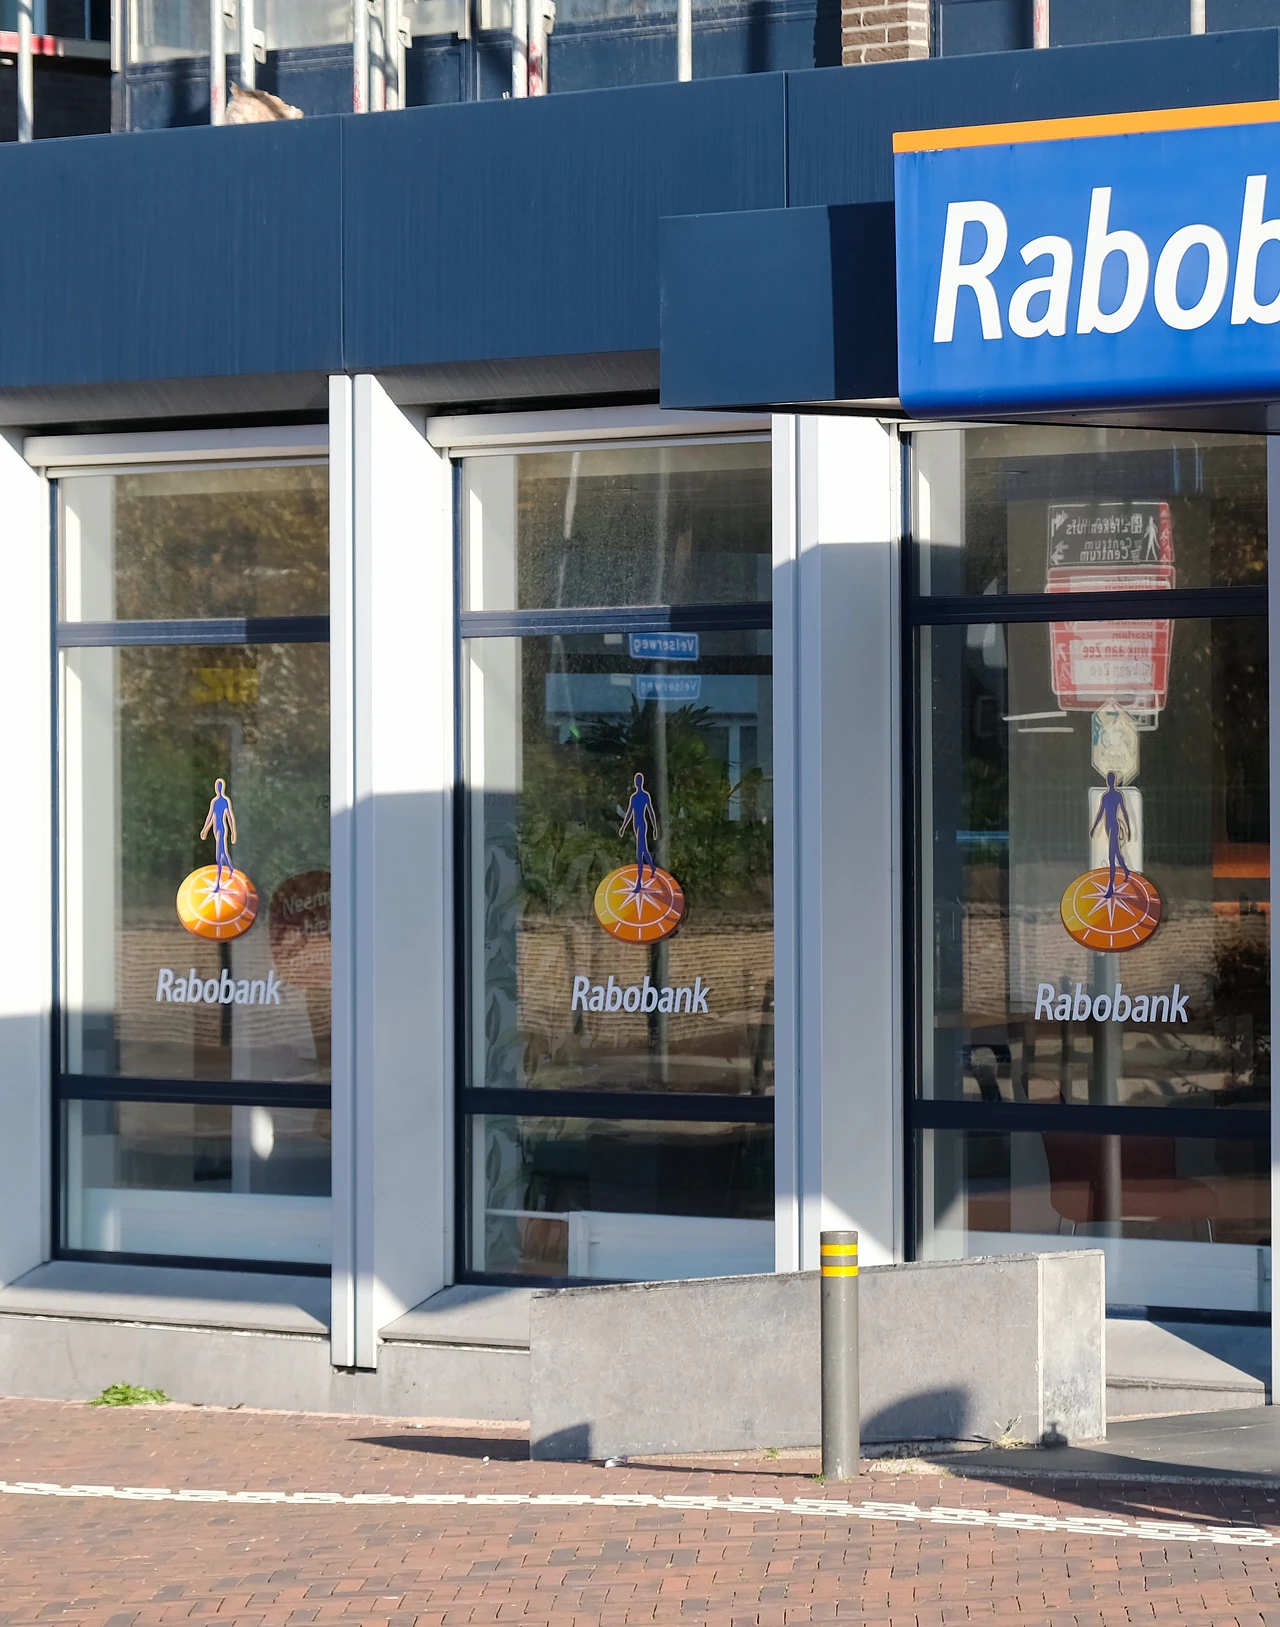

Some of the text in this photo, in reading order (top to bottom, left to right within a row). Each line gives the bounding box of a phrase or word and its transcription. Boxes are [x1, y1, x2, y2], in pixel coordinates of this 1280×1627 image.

[155, 967, 282, 1006] Rabobank
[570, 974, 710, 1015] Rabobank
[1033, 982, 1191, 1024] Rabobank
